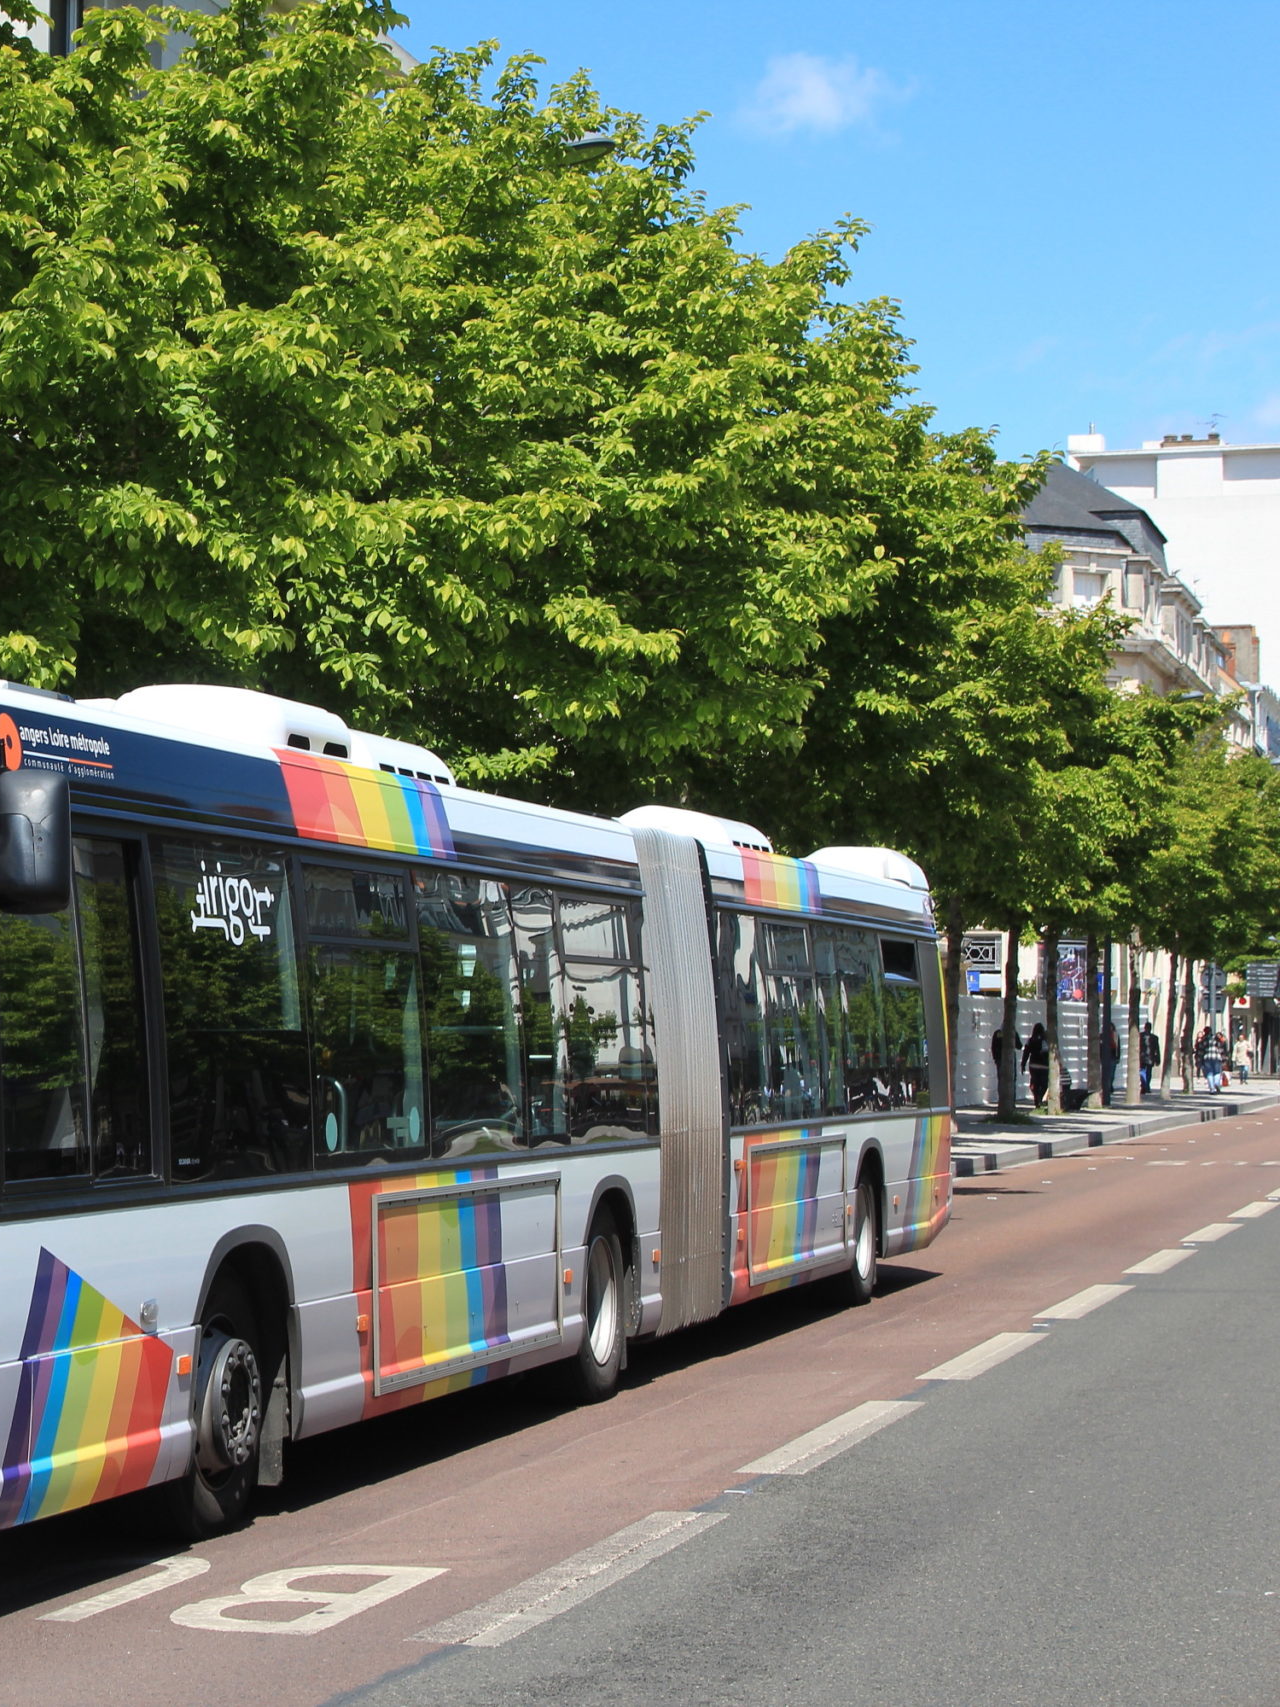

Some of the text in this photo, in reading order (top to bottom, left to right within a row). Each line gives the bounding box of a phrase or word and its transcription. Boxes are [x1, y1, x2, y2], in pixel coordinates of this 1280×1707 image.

[19, 725, 111, 758] angers loire métropole
[23, 757, 115, 780] communauté d'agglomération
